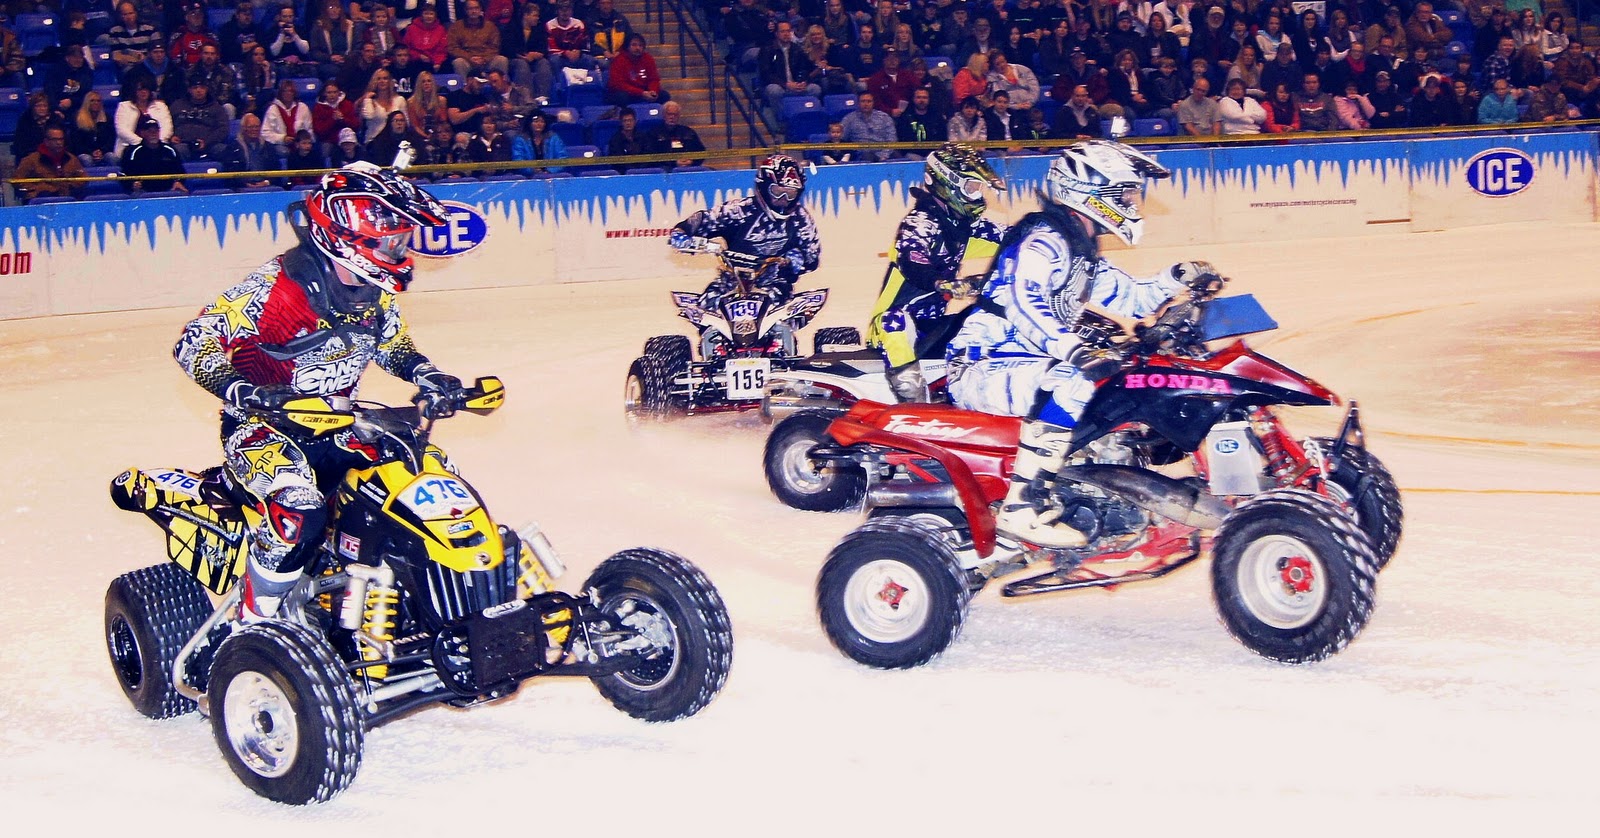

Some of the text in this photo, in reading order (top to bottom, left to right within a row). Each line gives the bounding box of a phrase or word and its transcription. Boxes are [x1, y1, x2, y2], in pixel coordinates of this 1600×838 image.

[1477, 158, 1523, 191] ICE
[728, 303, 758, 321] 159
[987, 359, 1039, 372] SHIFT
[1125, 373, 1232, 394] HONDA
[157, 472, 200, 490] 476
[414, 479, 469, 506] 476
